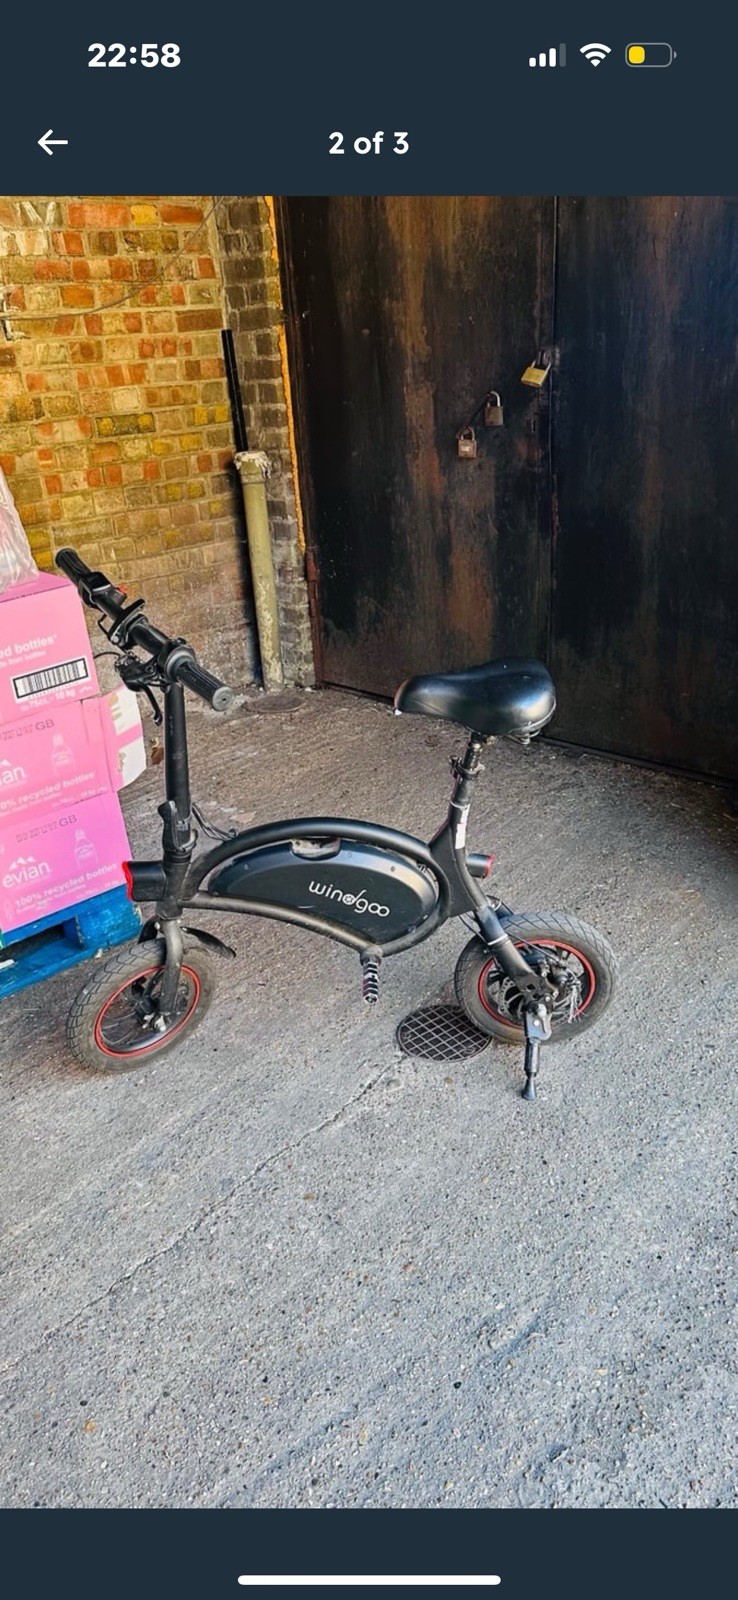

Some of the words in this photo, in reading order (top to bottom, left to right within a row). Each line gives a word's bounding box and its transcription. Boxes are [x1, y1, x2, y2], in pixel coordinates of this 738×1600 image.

[35, 719, 55, 731] GB
[18, 782, 60, 803] recycled
[58, 814, 77, 827] GB
[3, 862, 50, 888] evian
[44, 875, 84, 895] recycled
[308, 881, 390, 917] windgoo
